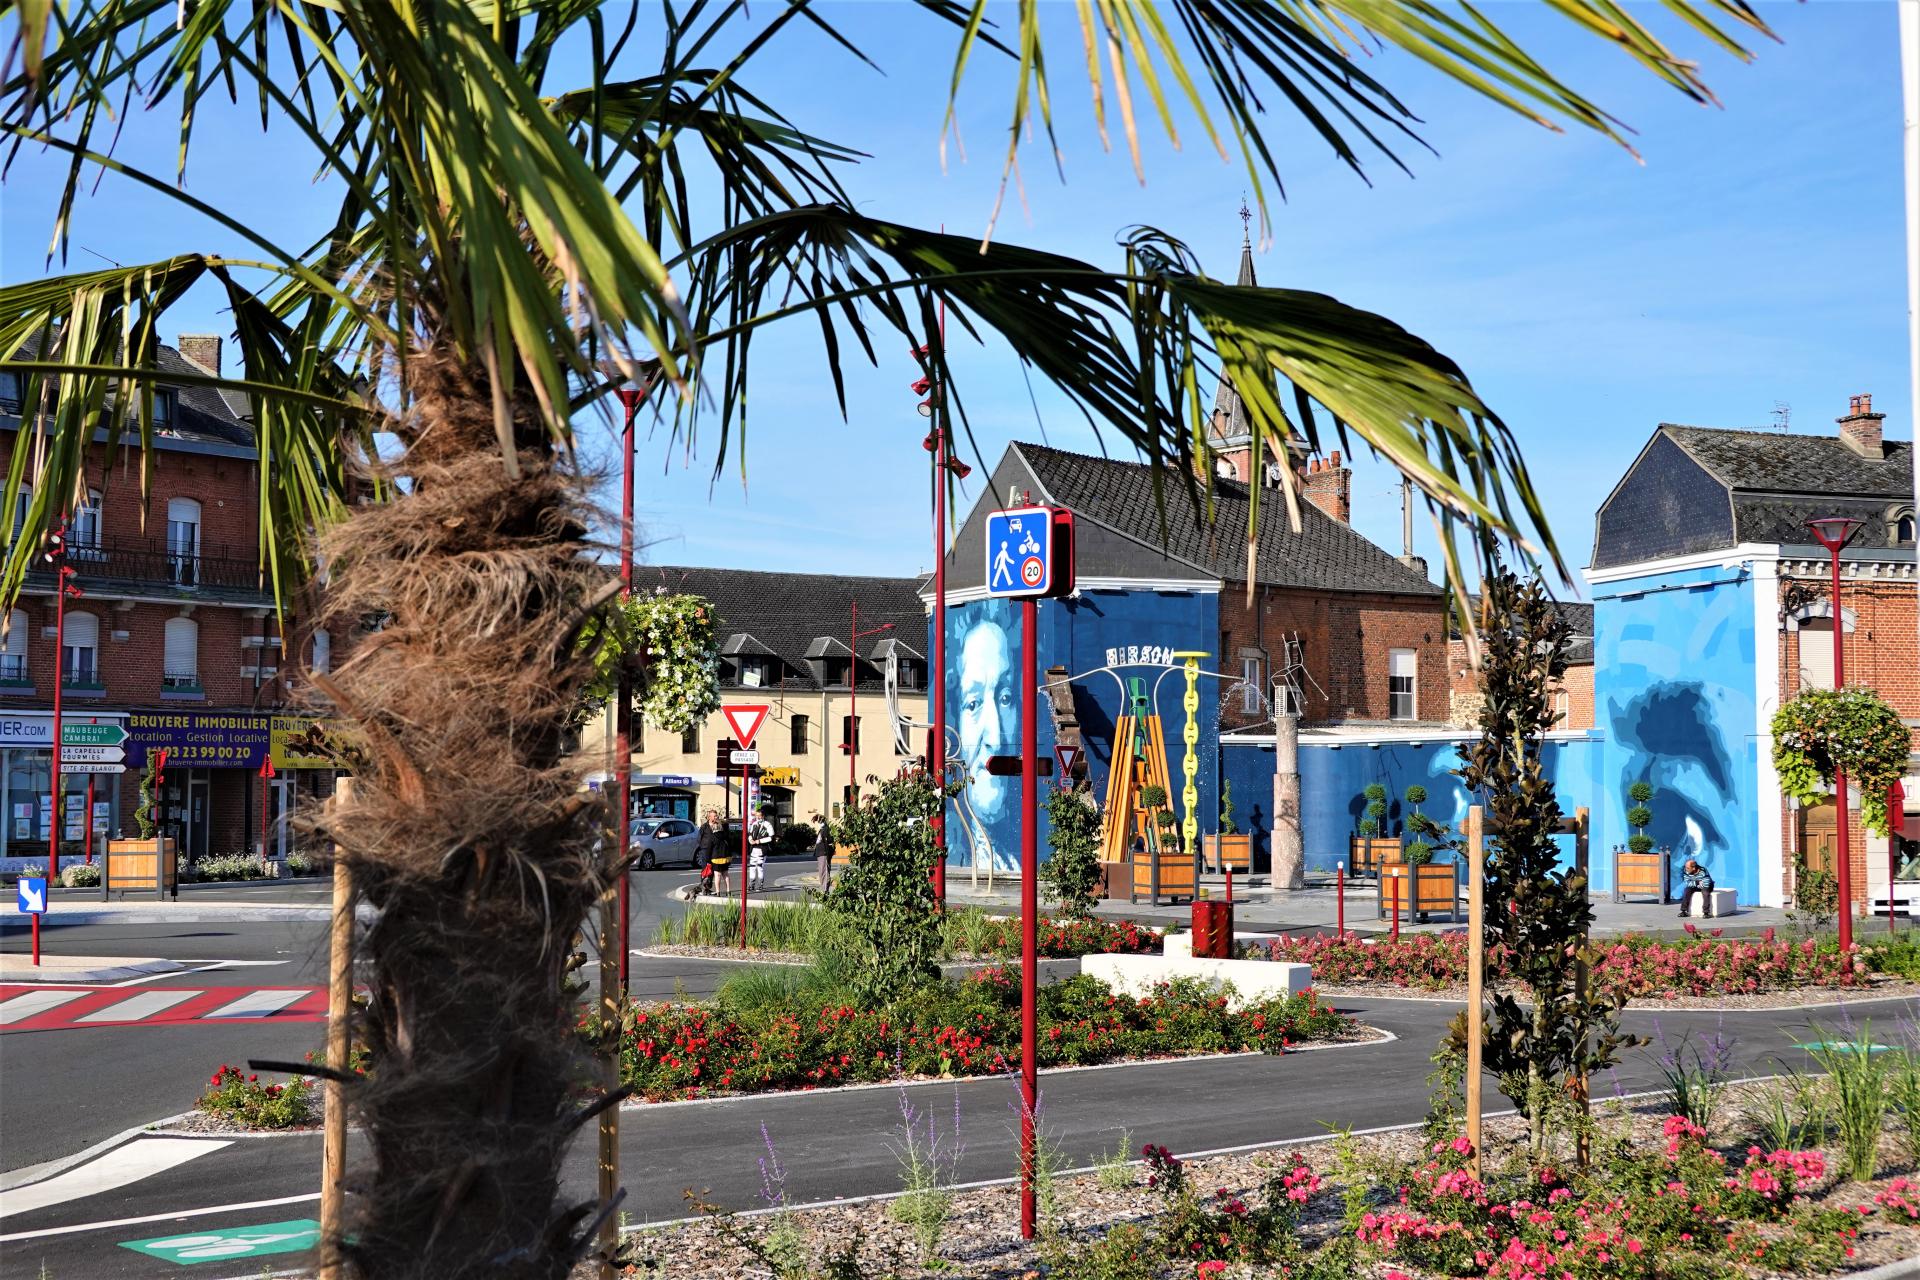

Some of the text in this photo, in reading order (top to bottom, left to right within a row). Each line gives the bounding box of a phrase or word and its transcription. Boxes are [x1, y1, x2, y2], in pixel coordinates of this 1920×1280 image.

[1027, 566, 1039, 577] 20
[1106, 645, 1174, 667] HIRSON
[130, 715, 268, 730] BRUYERE IMMOBILIER
[64, 726, 108, 734] MAUBEUGE
[129, 732, 172, 742] Location
[186, 732, 224, 742] Gestion
[229, 733, 268, 743] Locative
[182, 746, 197, 758] 23
[200, 747, 215, 758] 99
[218, 747, 233, 759] 00
[236, 747, 251, 759] 20
